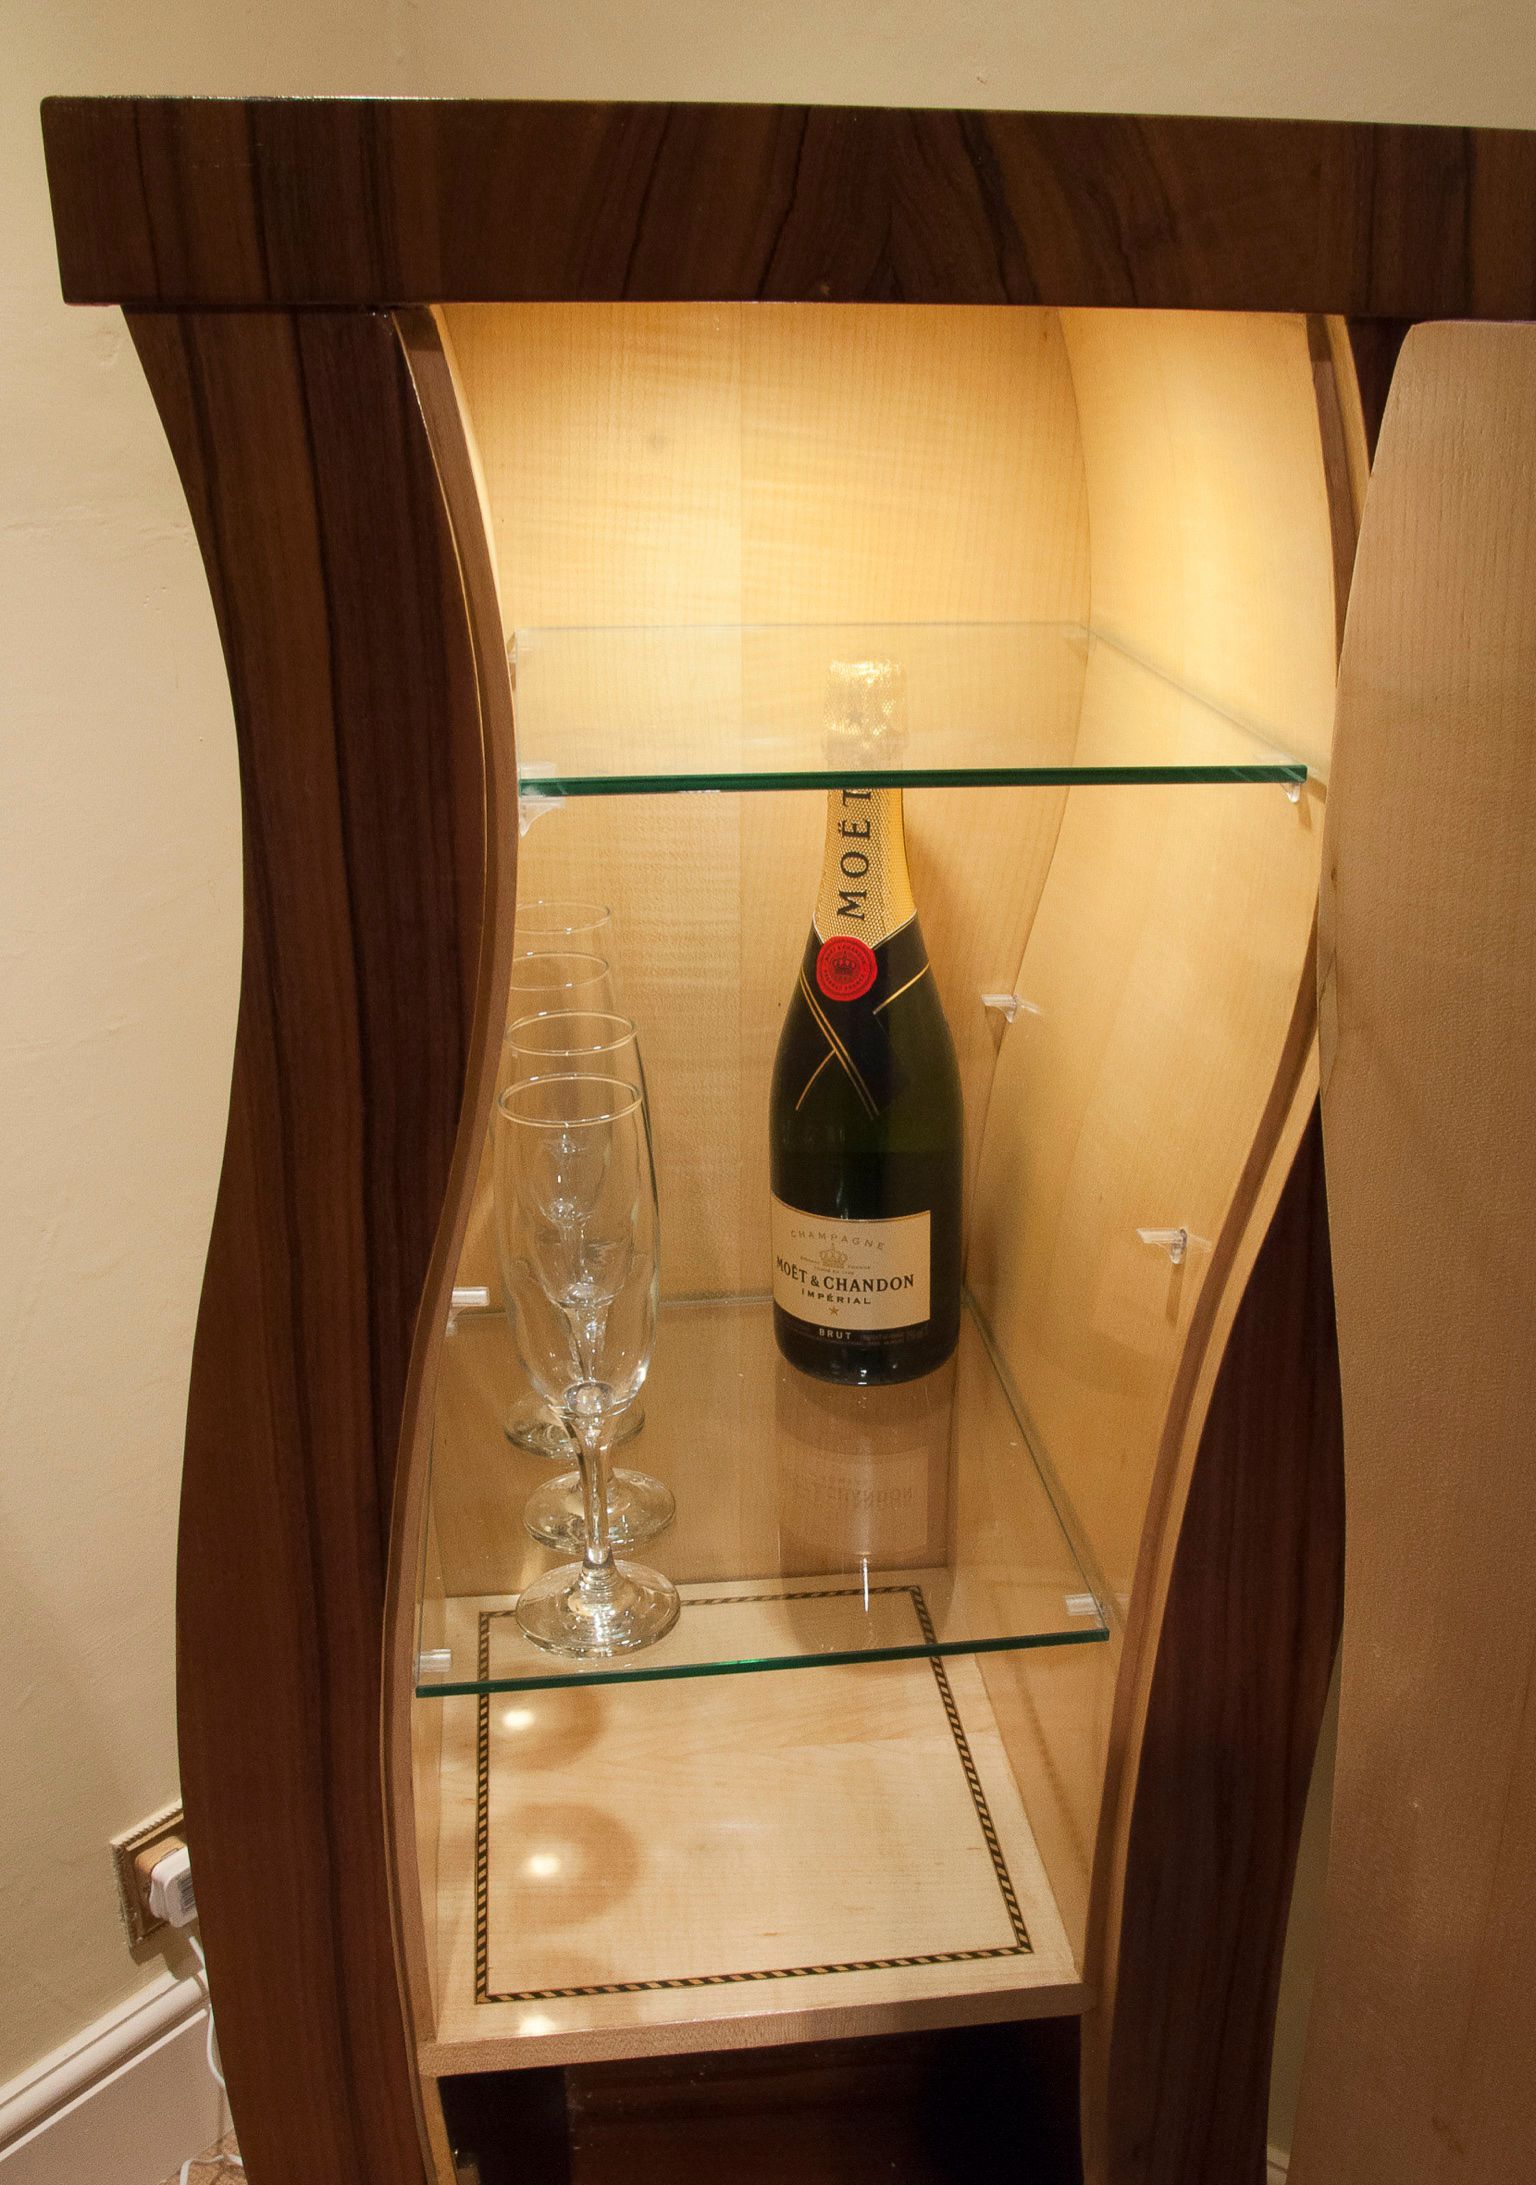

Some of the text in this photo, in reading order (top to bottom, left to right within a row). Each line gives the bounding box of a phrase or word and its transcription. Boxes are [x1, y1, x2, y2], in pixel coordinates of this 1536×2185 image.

[790, 1230, 886, 1251] CHAMPAGNE
[776, 1256, 808, 1283] MOËT
[810, 1275, 820, 1287] &
[823, 1274, 915, 1292] CHANDON
[801, 1288, 872, 1305] IMPÉRIAL
[818, 1328, 852, 1340] BRUT
